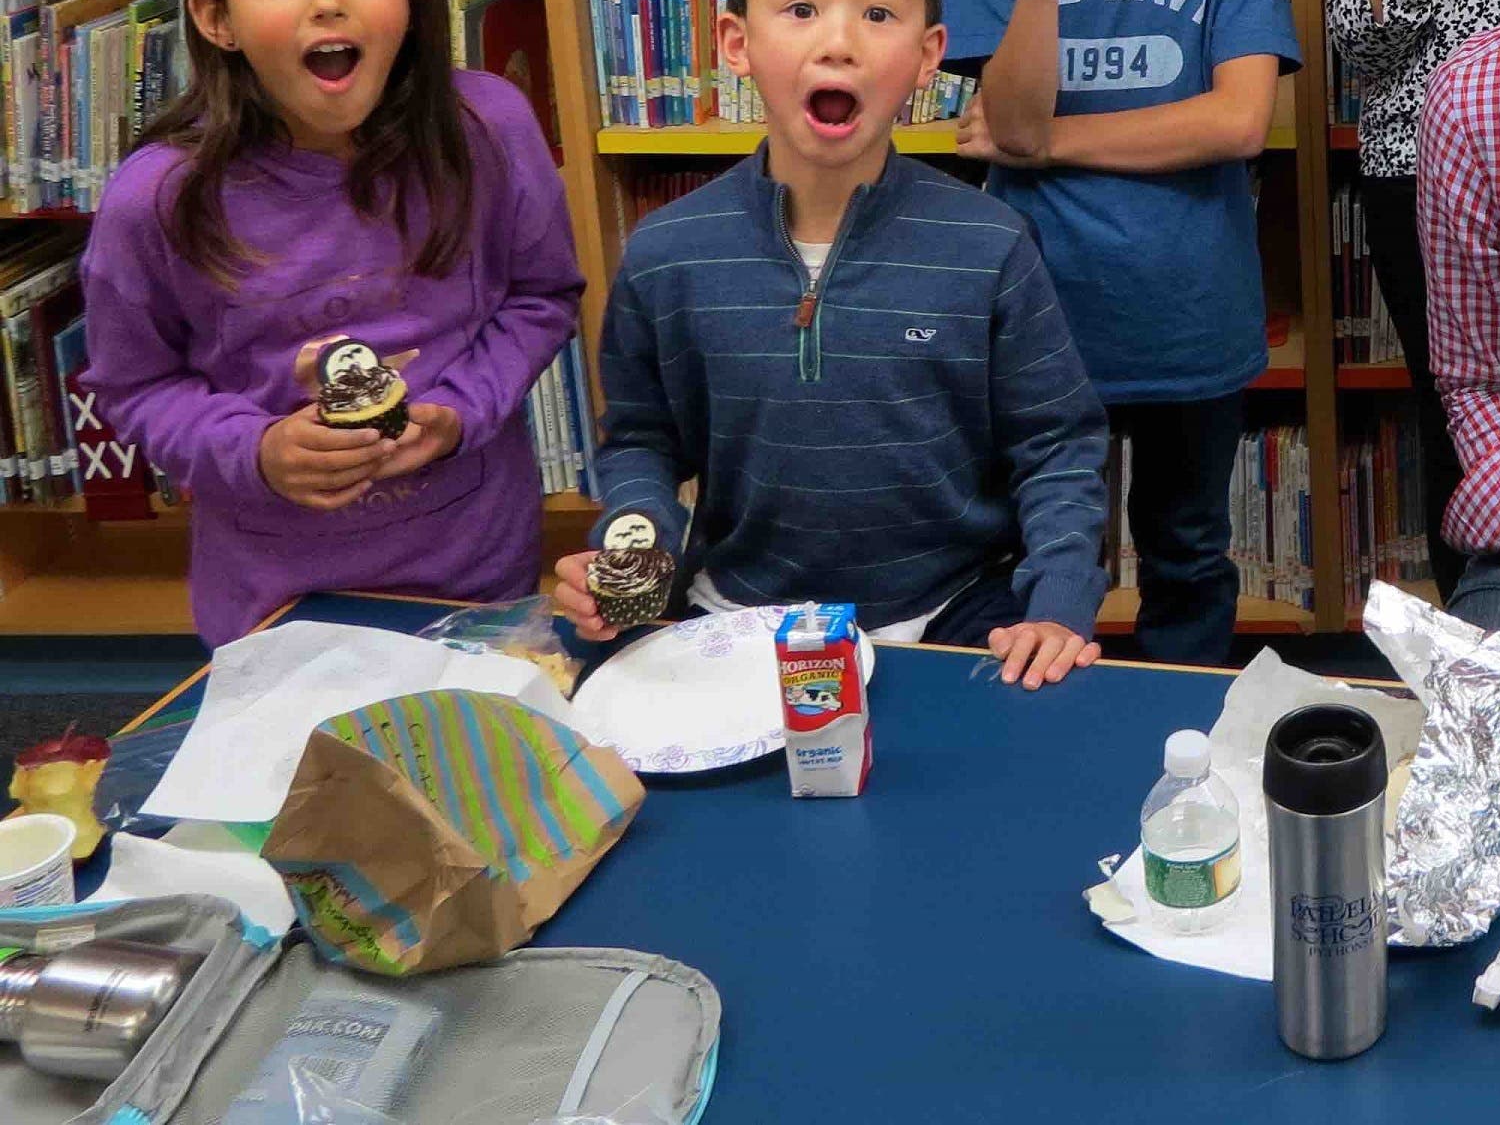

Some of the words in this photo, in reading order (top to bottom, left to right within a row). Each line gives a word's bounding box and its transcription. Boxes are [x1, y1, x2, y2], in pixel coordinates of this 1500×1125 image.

[1066, 44, 1149, 82] 1994
[70, 391, 103, 431] X
[80, 440, 137, 481] XY
[781, 656, 846, 676] HORIZON
[783, 670, 839, 686] ORGANIC
